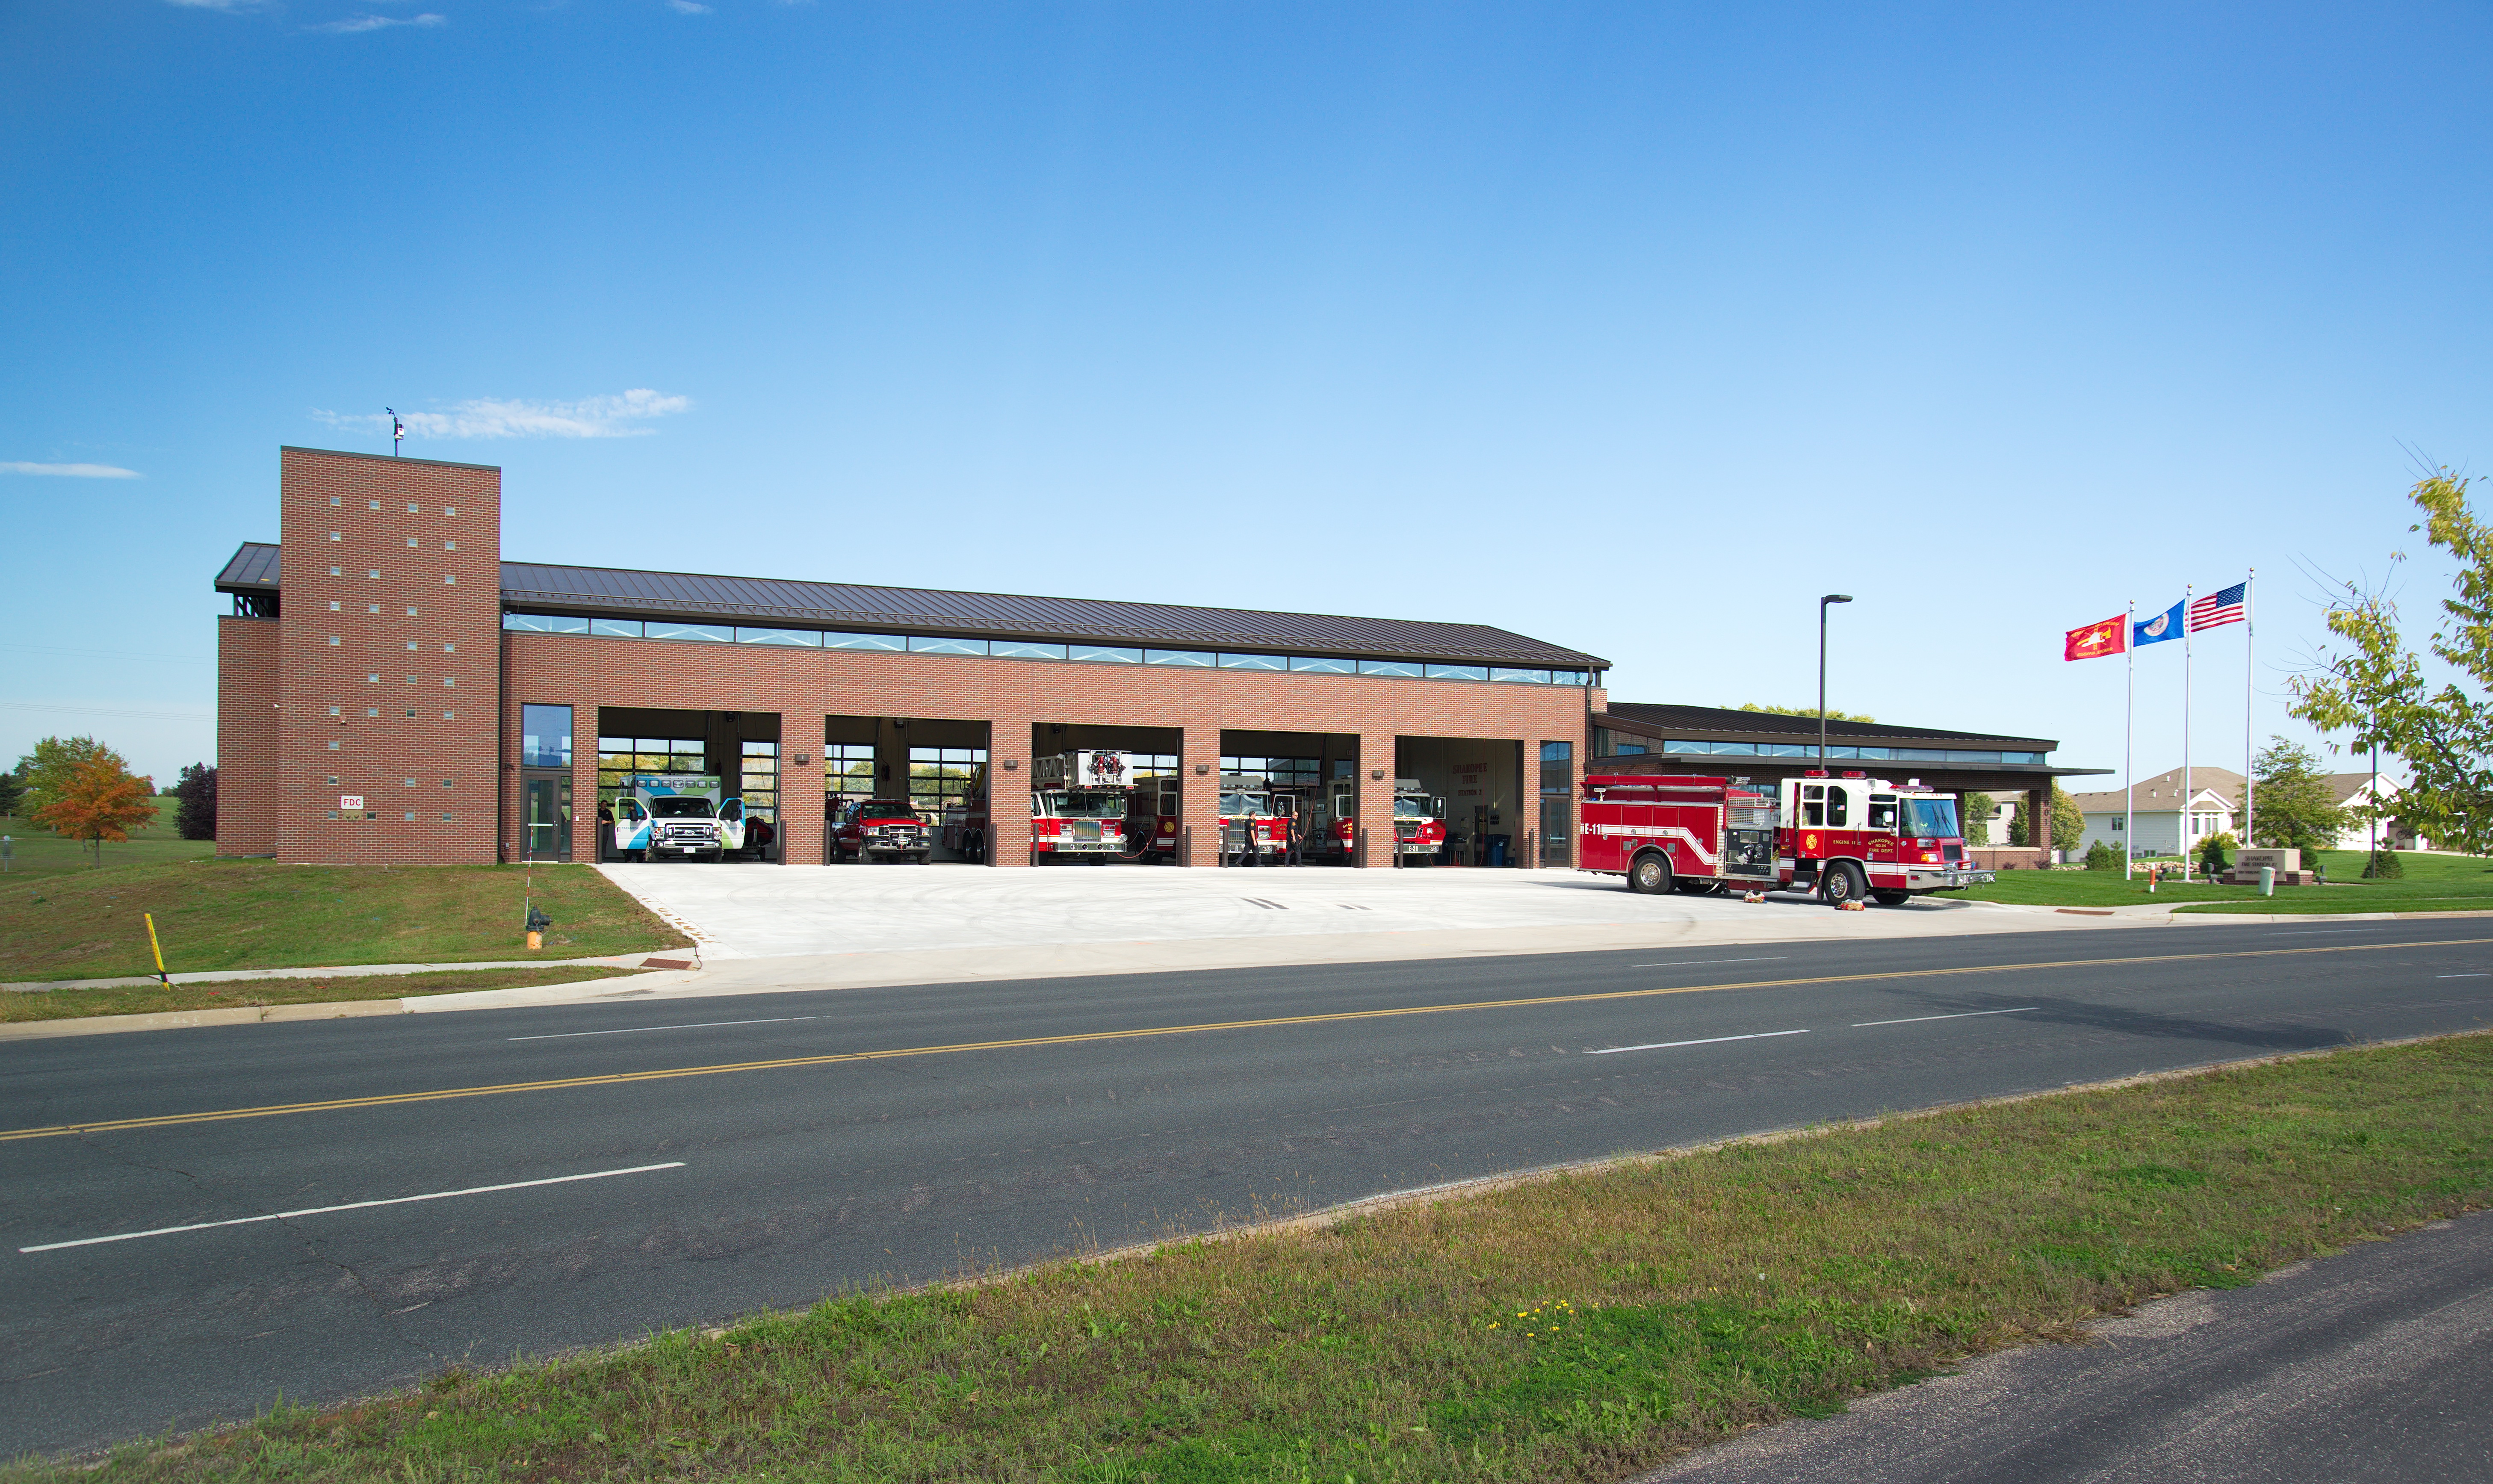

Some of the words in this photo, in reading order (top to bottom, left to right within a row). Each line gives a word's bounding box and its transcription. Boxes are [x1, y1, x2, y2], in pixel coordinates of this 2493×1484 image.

[1453, 763, 1487, 774] SHAKOPEE
[1462, 775, 1477, 784] FIRE
[1585, 823, 1600, 835] E-11
[1868, 838, 1894, 847] SHAKOPEE
